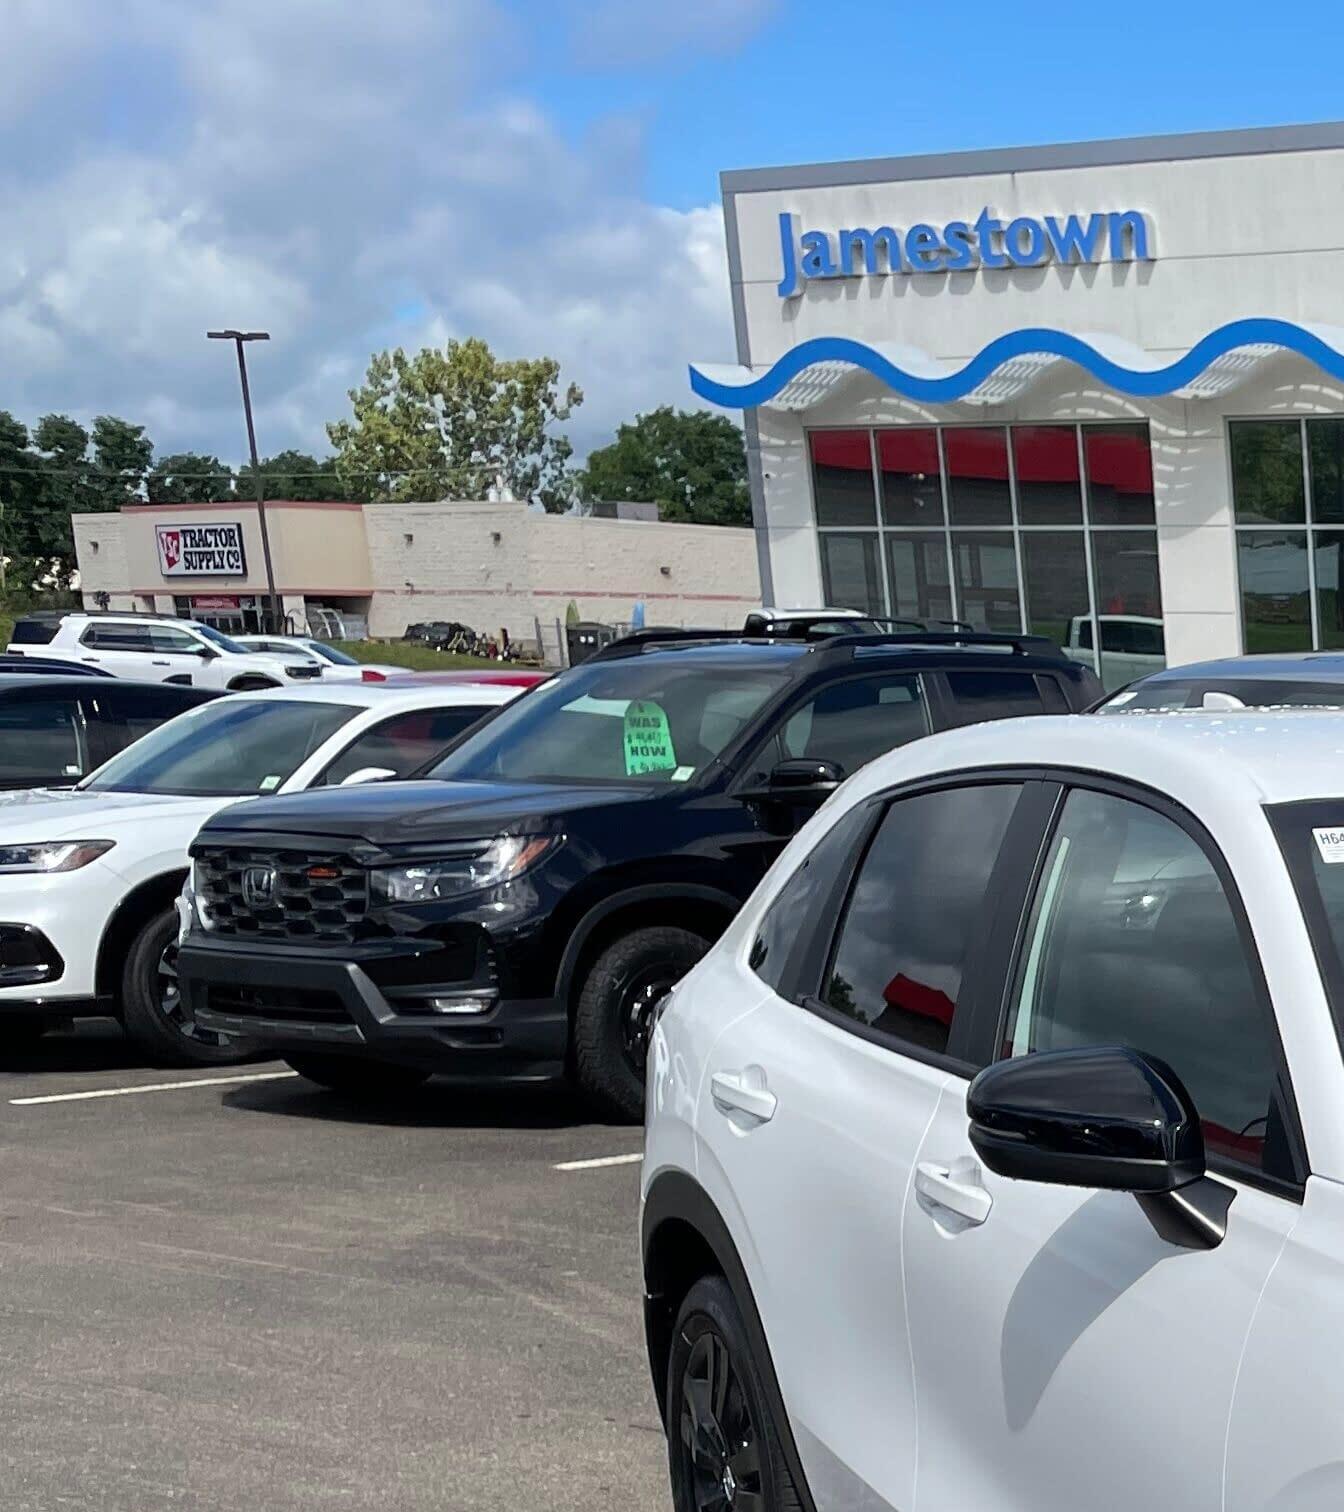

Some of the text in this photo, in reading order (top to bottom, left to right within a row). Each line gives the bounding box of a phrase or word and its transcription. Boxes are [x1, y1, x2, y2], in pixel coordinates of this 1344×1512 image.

[777, 206, 1149, 298] Jamestown
[180, 528, 238, 548] TRACTOR
[184, 550, 225, 570] SUPPLY
